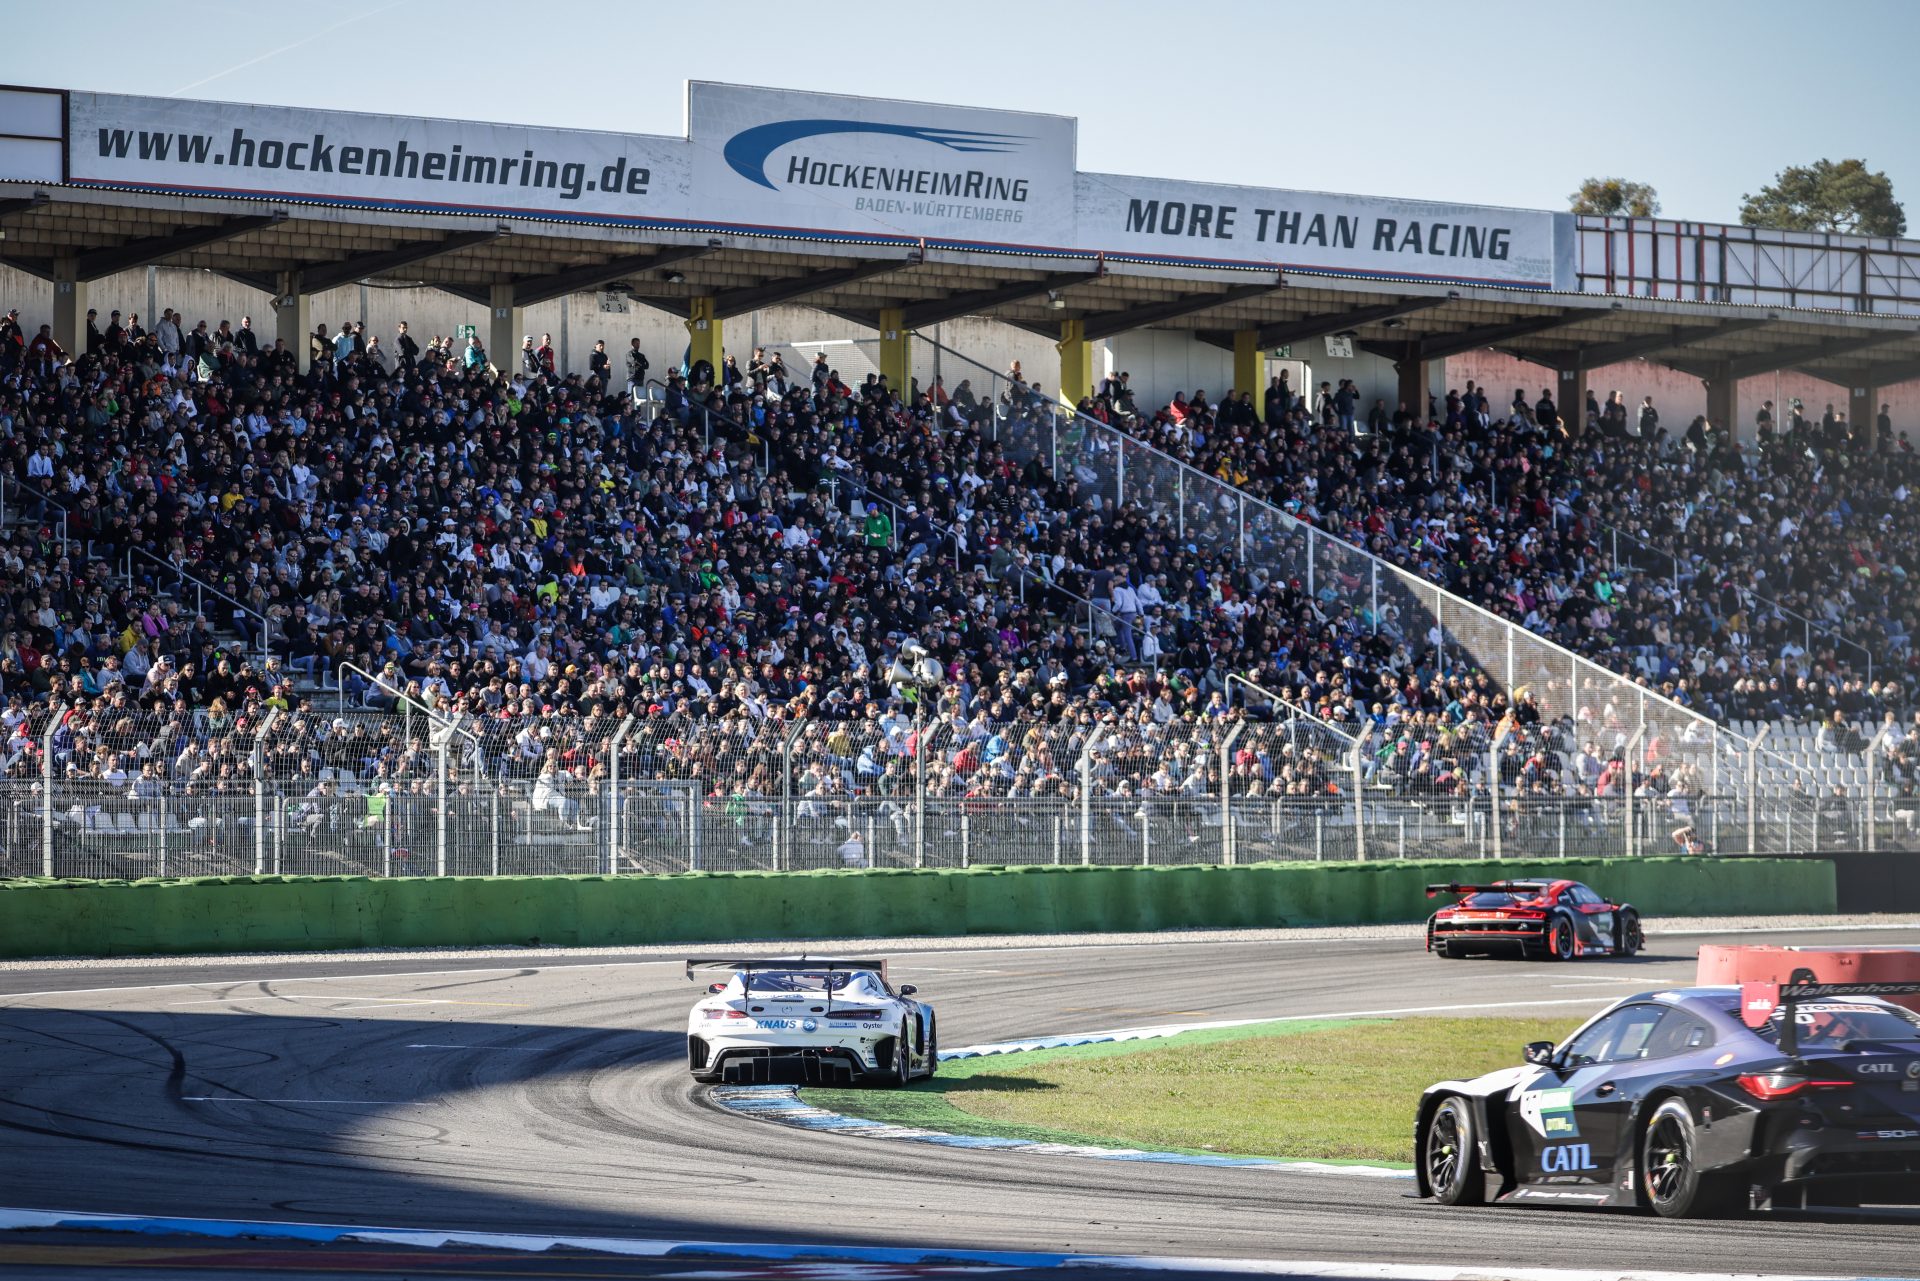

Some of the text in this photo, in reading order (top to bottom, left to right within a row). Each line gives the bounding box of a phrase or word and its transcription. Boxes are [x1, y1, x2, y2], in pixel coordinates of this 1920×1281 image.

[98, 127, 651, 200] www.hockenheimring.de
[855, 196, 1024, 223] BADEN-WÜRTTEMBERG
[1125, 198, 1511, 261] MORE THAN RACING
[755, 1018, 797, 1029] KNAUS
[862, 1022, 883, 1030] Oyster
[1857, 1063, 1899, 1074] CATL
[1541, 1143, 1598, 1173] CATL
